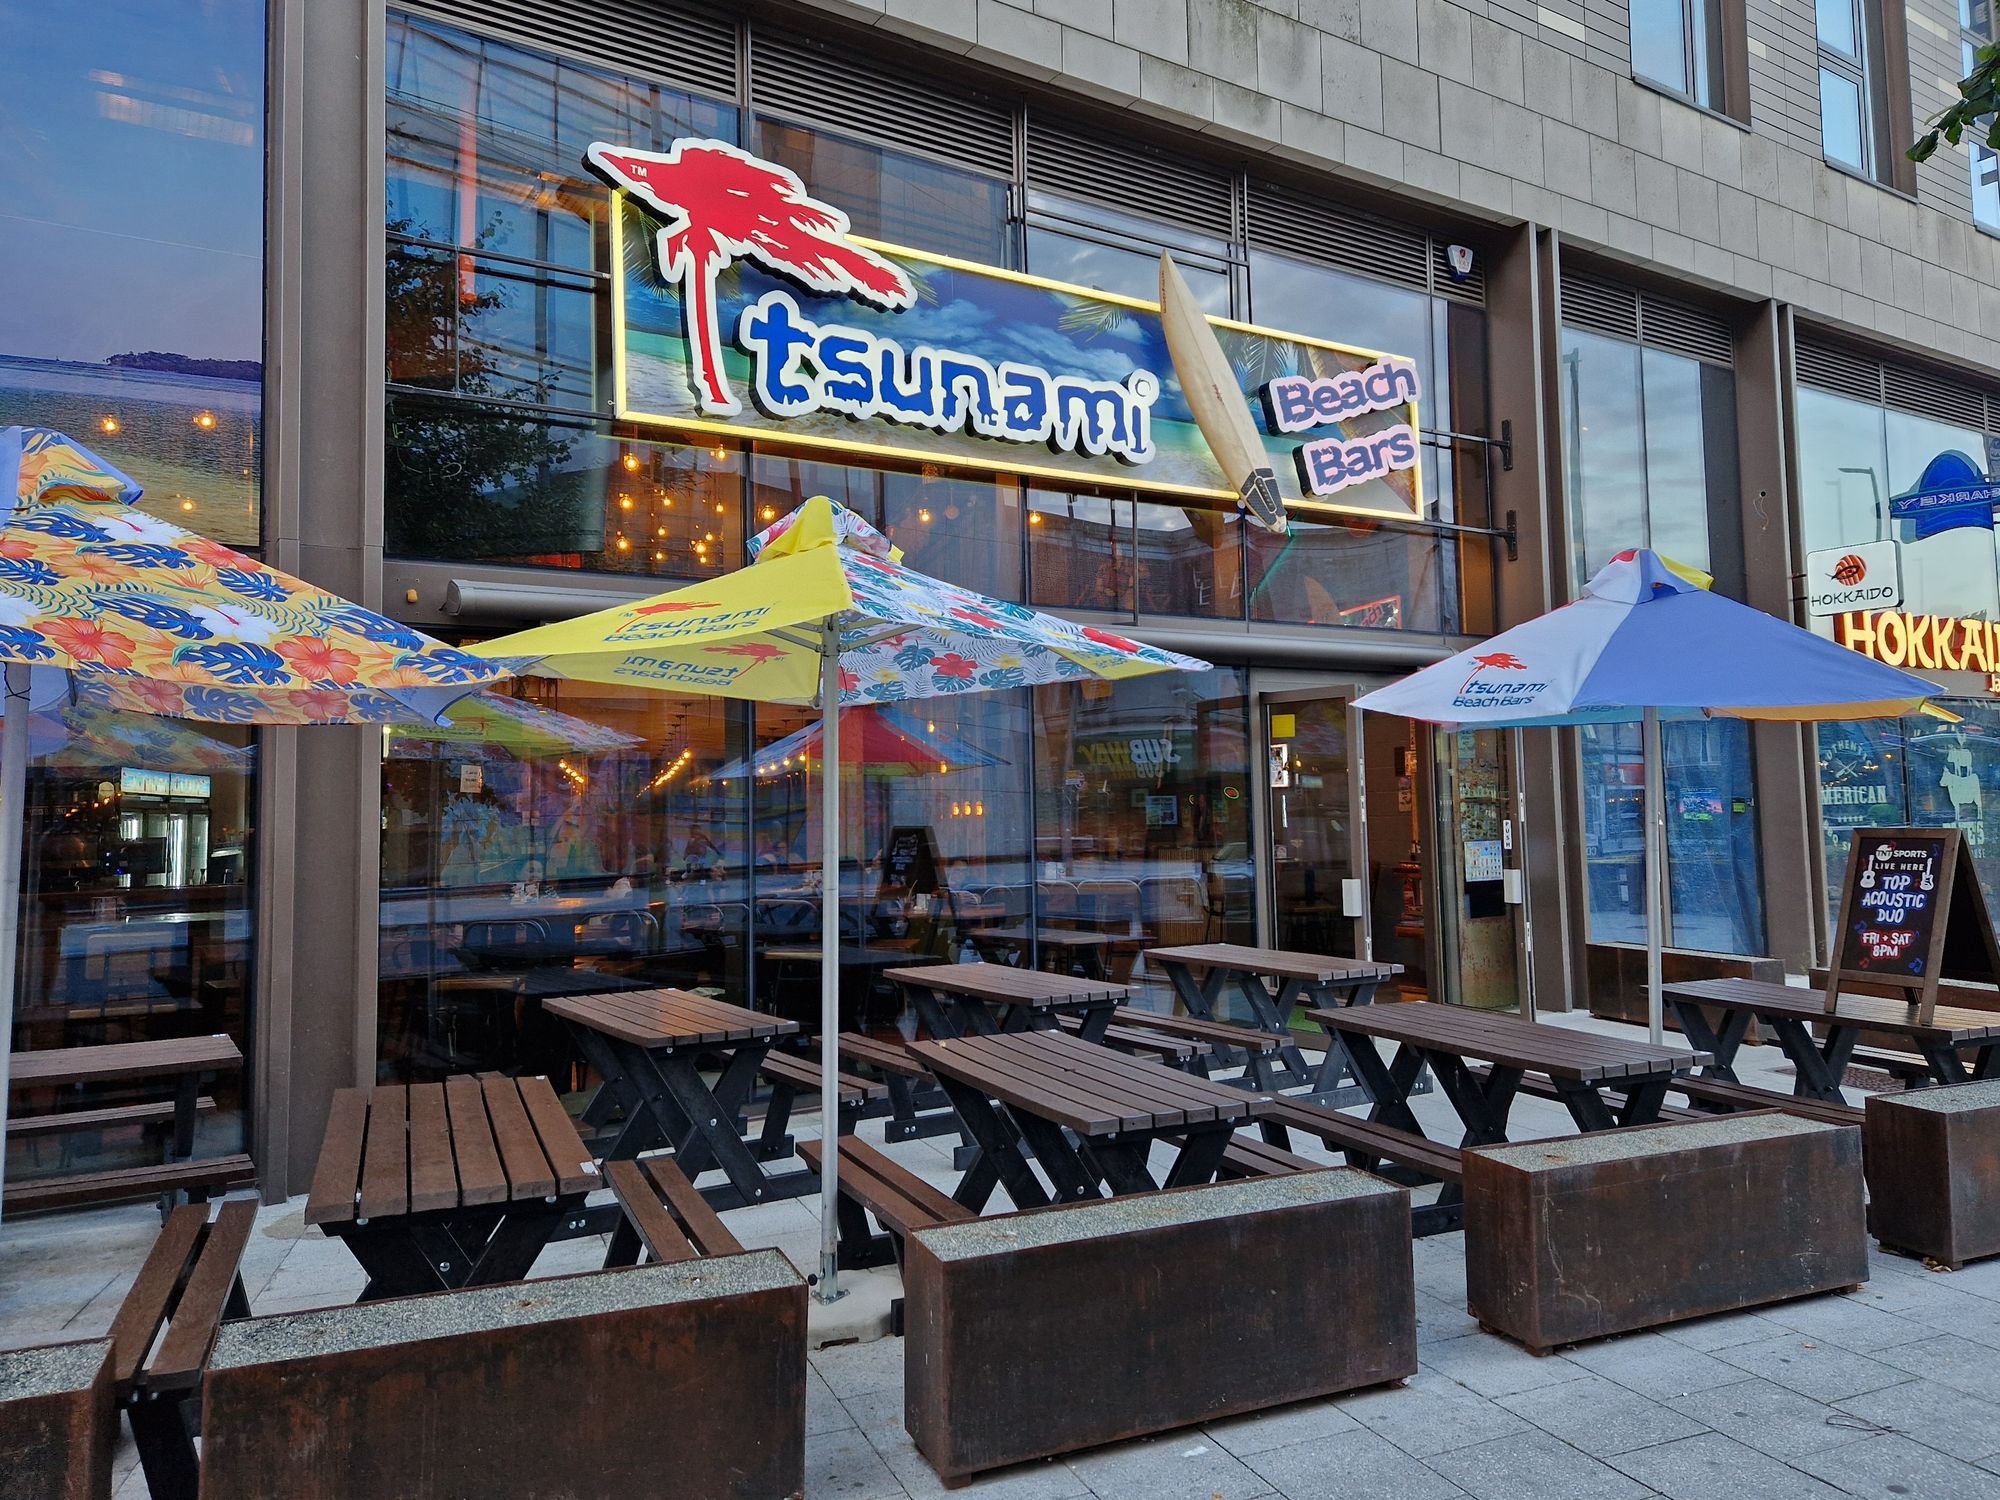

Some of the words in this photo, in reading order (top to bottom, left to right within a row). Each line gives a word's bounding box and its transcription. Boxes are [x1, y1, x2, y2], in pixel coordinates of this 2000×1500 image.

[630, 165, 648, 178] TM
[751, 303, 1155, 454] tsunami
[1277, 363, 1417, 425] Beach
[1310, 432, 1415, 487] Bars
[1811, 586, 1894, 607] HOKKAIDO
[627, 607, 771, 631] tsunami
[603, 628, 693, 642] Beach
[695, 619, 759, 634] Bars
[1466, 680, 1549, 694] tsunami
[1452, 696, 1498, 708] Beach
[1500, 695, 1535, 707] Bars
[1822, 739, 1874, 768] UTHENTIC
[1821, 785, 1888, 805] MERICAN
[1893, 850, 1928, 858] SPORTS
[1900, 863, 1925, 871] HERE
[1883, 875, 1910, 891] TOP
[1862, 891, 1925, 908] ACOUSTIC
[1877, 908, 1904, 923] DUO
[1863, 932, 1879, 944] FRI
[1891, 933, 1912, 945] SAT
[1872, 944, 1898, 957] 8PM
